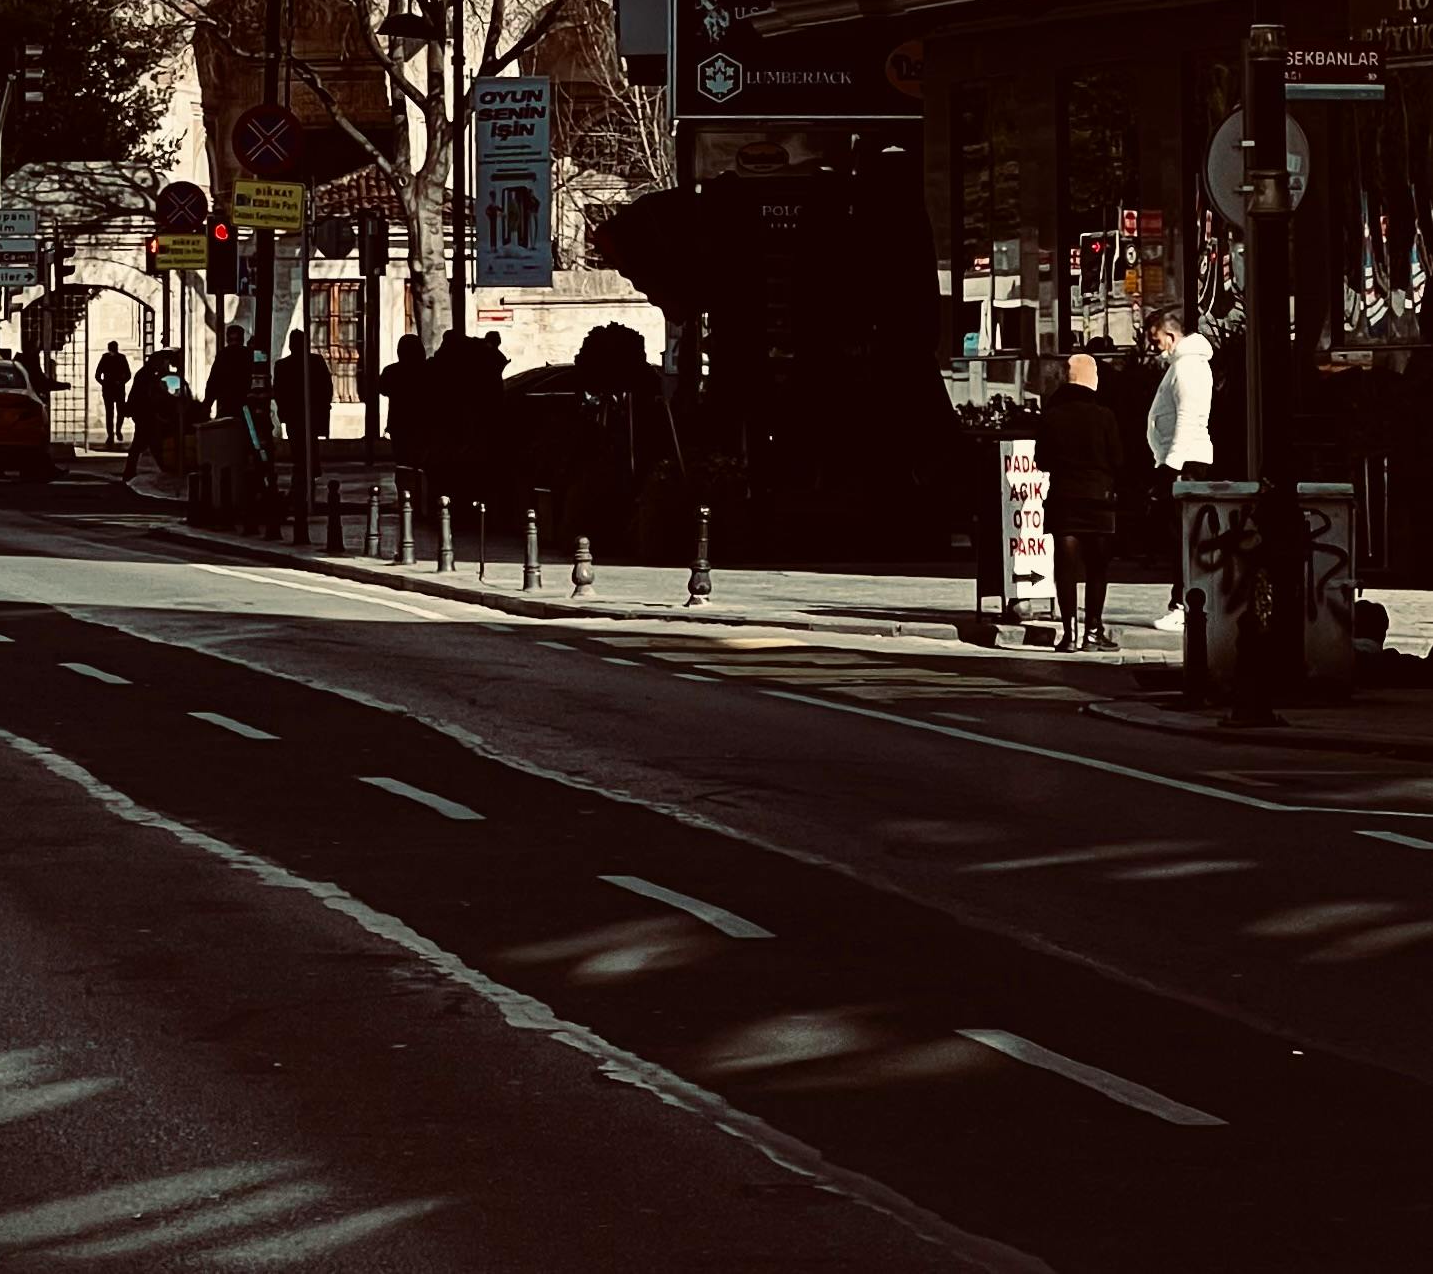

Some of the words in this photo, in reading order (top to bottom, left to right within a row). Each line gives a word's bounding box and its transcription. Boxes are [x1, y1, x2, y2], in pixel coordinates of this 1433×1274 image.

[1286, 51, 1379, 66] SEKBANLAR
[746, 70, 852, 85] LUMBERJACK
[480, 89, 543, 104] OYUN
[478, 104, 546, 121] SENİN
[491, 121, 535, 141] İŞİN
[1013, 509, 1041, 529] OTO
[1009, 537, 1047, 557] PARK
